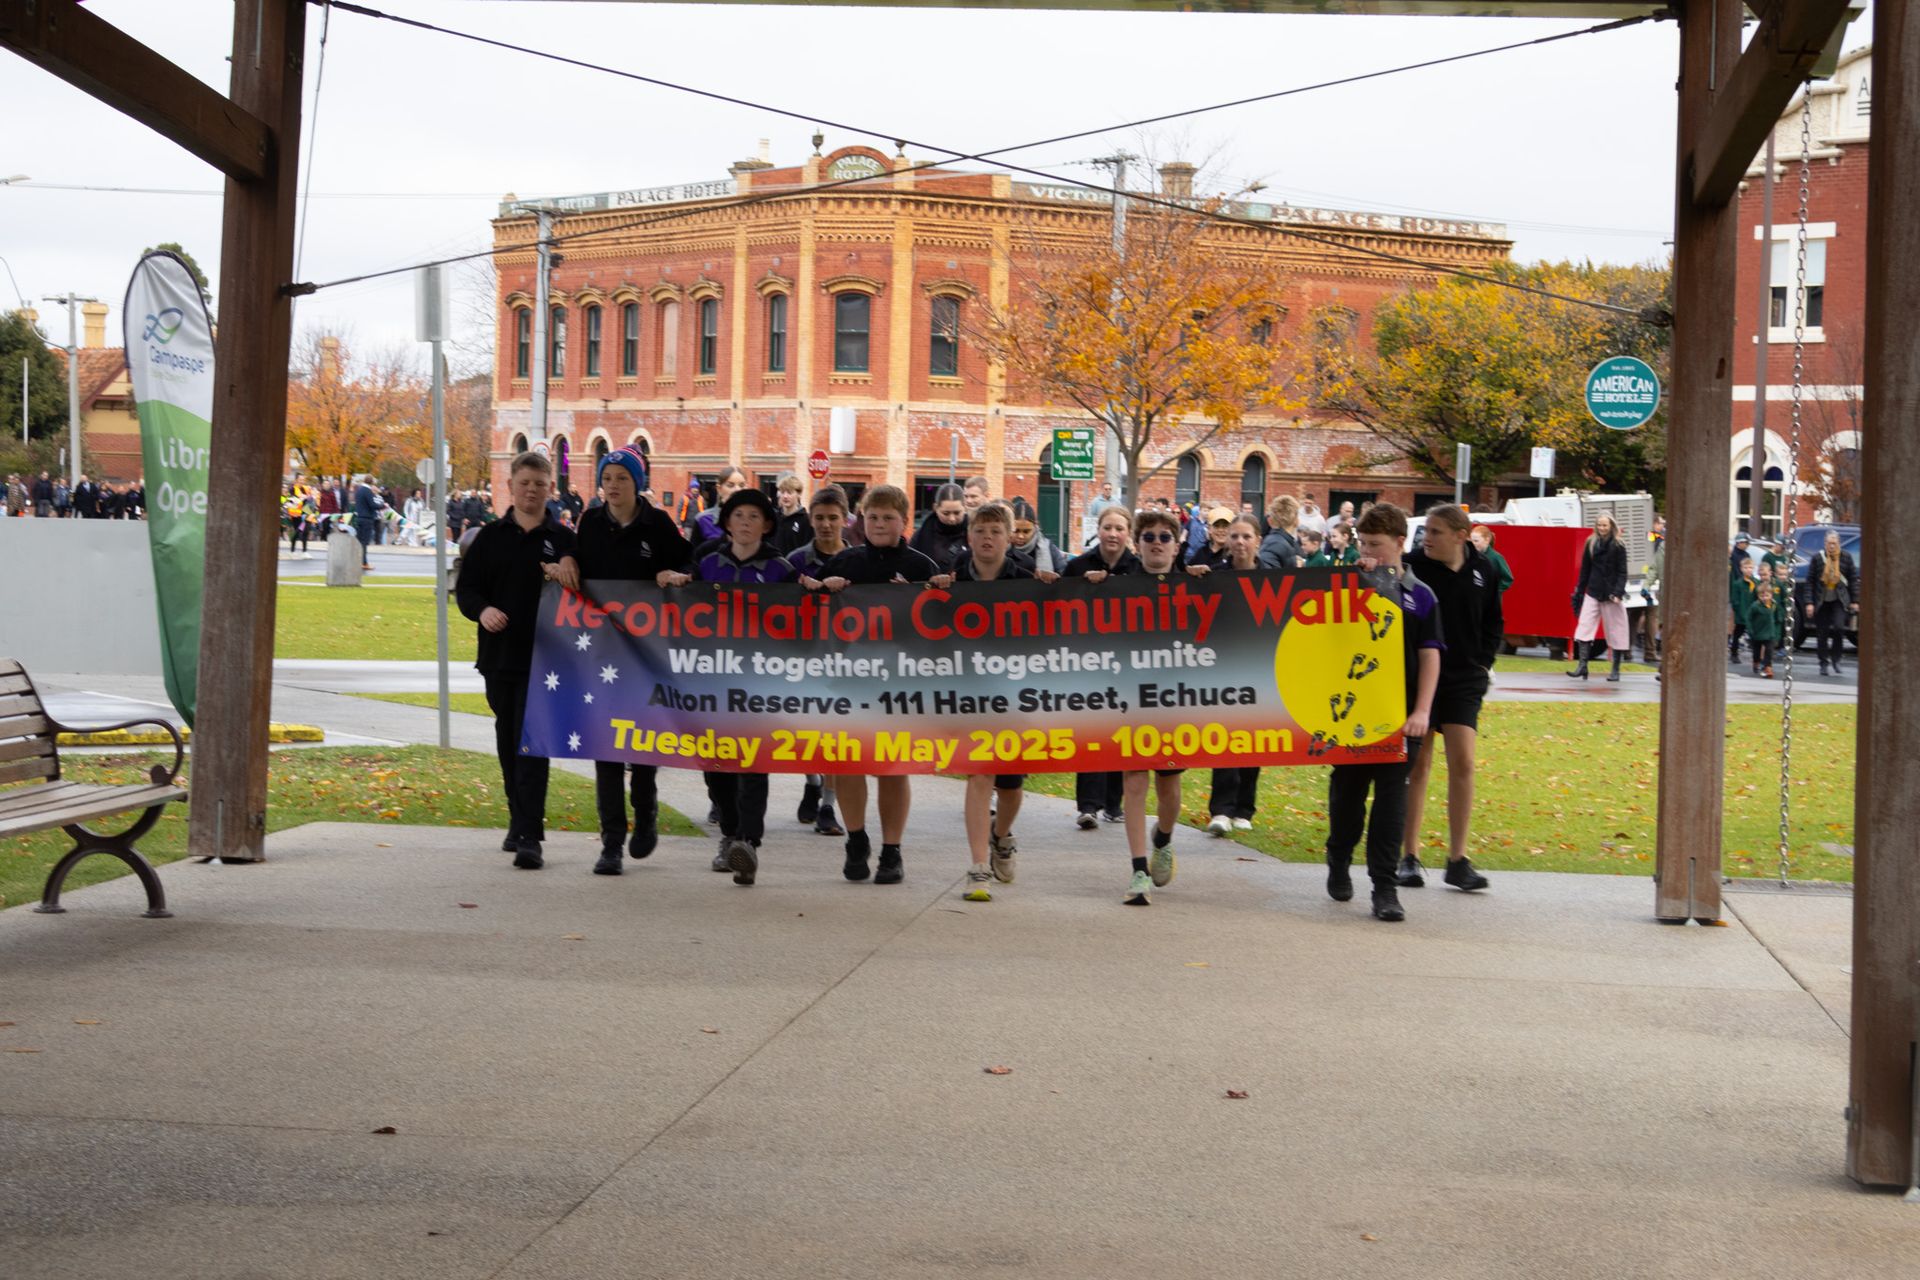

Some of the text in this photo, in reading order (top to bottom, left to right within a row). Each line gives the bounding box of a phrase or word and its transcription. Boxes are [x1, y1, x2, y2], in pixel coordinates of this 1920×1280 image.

[836, 155, 880, 171] PALACE
[617, 182, 731, 206] PALACE HOTEL
[1030, 186, 1126, 204] VICTOR
[1271, 205, 1488, 237] PALACE HOTEL
[1593, 375, 1654, 393] AMERICAN
[1605, 393, 1640, 403] HOTEL
[157, 481, 208, 519] Ope
[555, 573, 1378, 643] Reconciliation Community Walk
[668, 640, 1217, 682] Walk together, heal together, unite
[648, 683, 717, 713] Alton
[727, 688, 852, 715] Reserve
[879, 691, 925, 715] 111
[934, 691, 1009, 715] Hare
[1018, 686, 1128, 713] Street,
[1139, 682, 1256, 709] Echuca
[610, 718, 761, 768] Tuesday
[771, 729, 862, 762] 27th
[874, 731, 959, 769] May
[968, 728, 1076, 761] 2025
[1111, 722, 1293, 757] 10:00am
